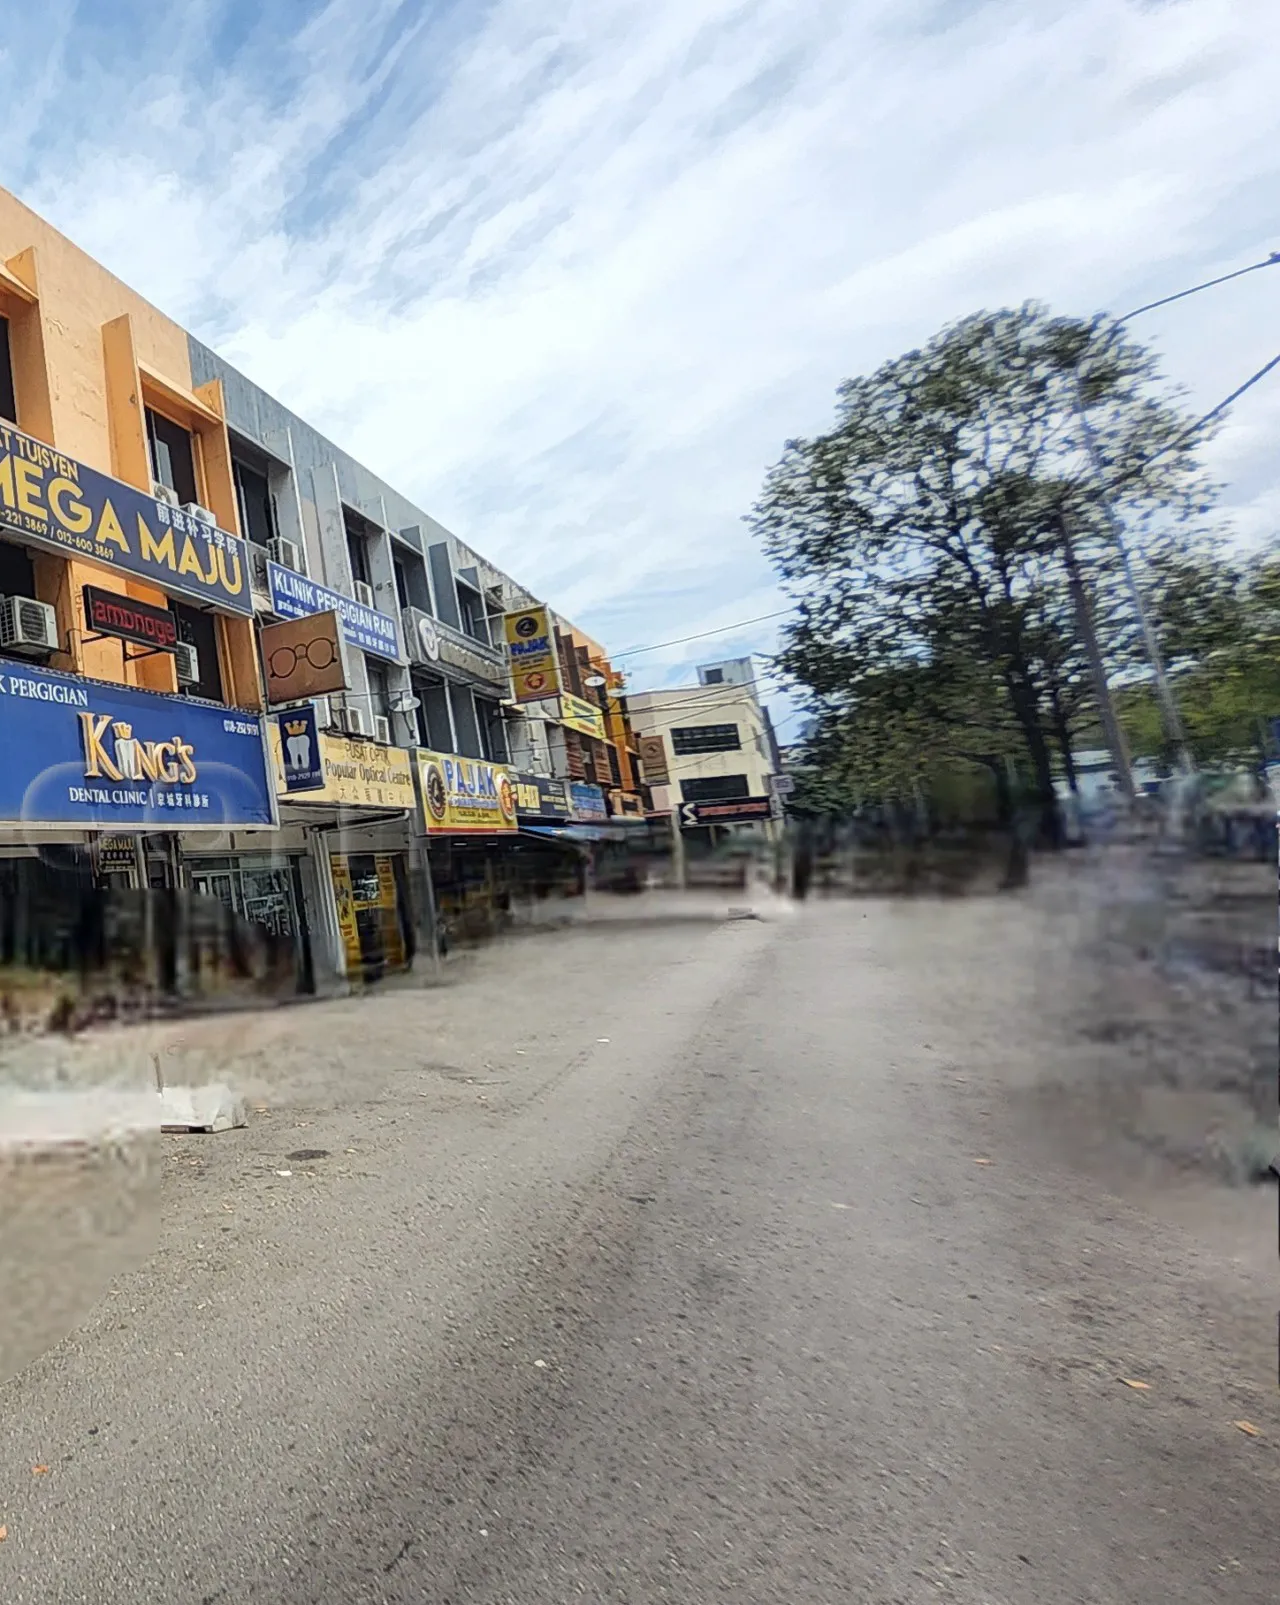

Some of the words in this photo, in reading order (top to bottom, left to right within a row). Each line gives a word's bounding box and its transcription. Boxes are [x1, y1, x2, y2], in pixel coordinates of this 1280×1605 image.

[15, 434, 80, 482] TUISYEN
[24, 517, 49, 537] 3869
[137, 511, 243, 596] MAJU
[274, 569, 316, 607] KLINIK
[315, 588, 373, 631] PERGIGIAN
[9, 676, 89, 707] PERGIGIAN
[324, 758, 357, 782] Popular
[359, 763, 387, 785] Optical
[441, 759, 498, 797] PAJAK
[69, 787, 111, 804] DENTAL
[112, 790, 147, 806] CLINIC
